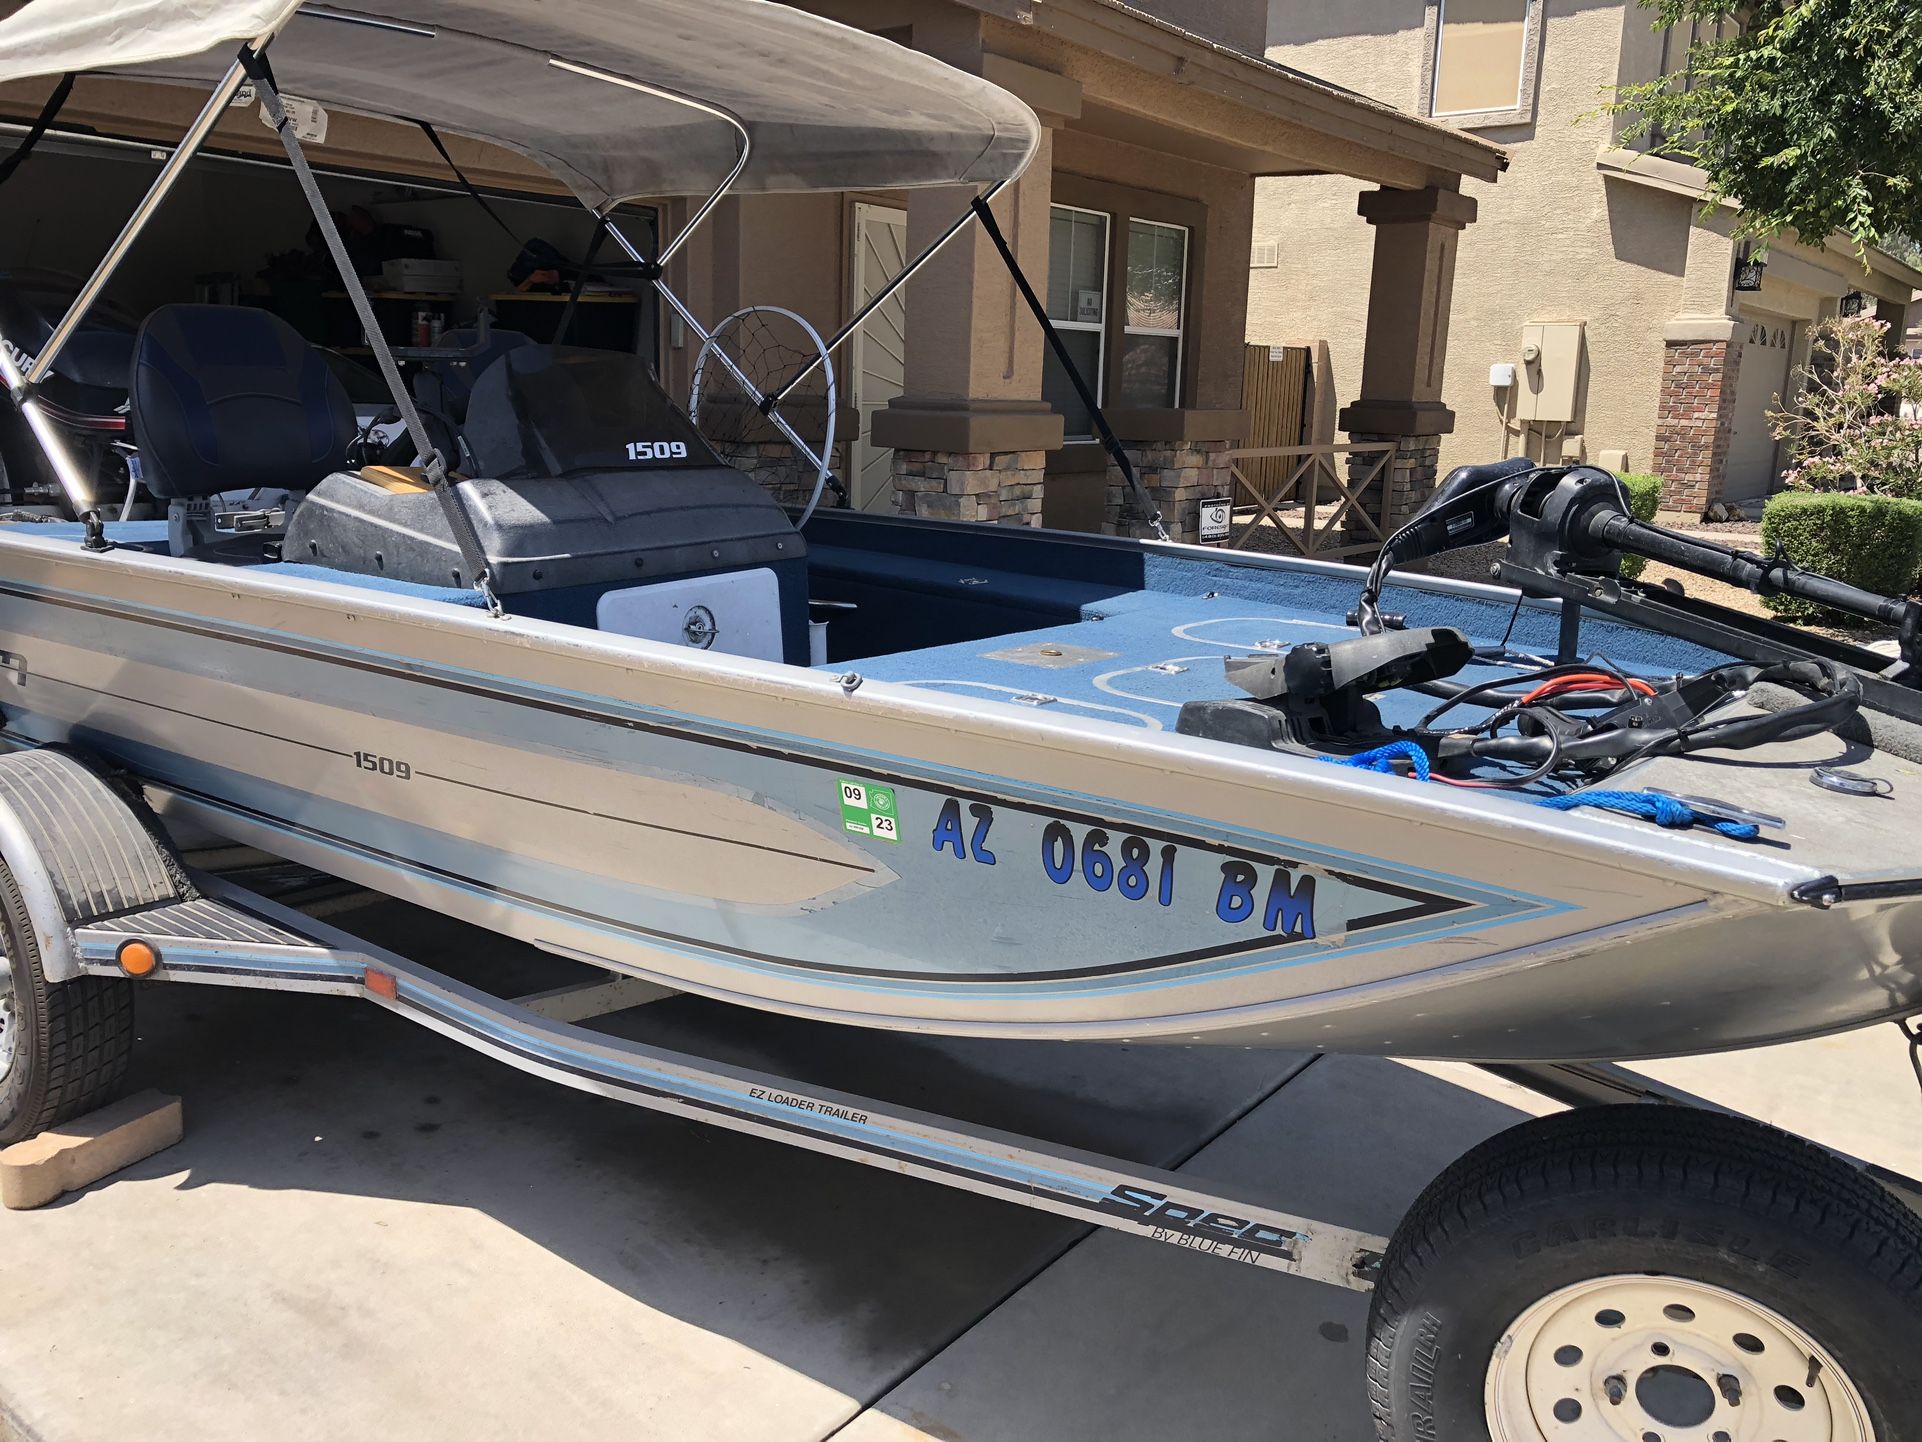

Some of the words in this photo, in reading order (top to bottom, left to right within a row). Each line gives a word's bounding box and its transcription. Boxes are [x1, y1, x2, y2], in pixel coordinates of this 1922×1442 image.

[625, 441, 687, 460] 1509
[353, 751, 411, 780] 1509
[844, 786, 862, 801] 09
[875, 816, 893, 832] 23
[932, 798, 996, 865] AZ
[1041, 820, 1177, 907] 0681
[1216, 860, 1316, 939] BM
[748, 1088, 766, 1100] EZ
[767, 1092, 815, 1112] LOADER
[818, 1104, 868, 1125] TRAILER
[1177, 1234, 1222, 1255] BLUE
[1227, 1247, 1261, 1264] FIN
